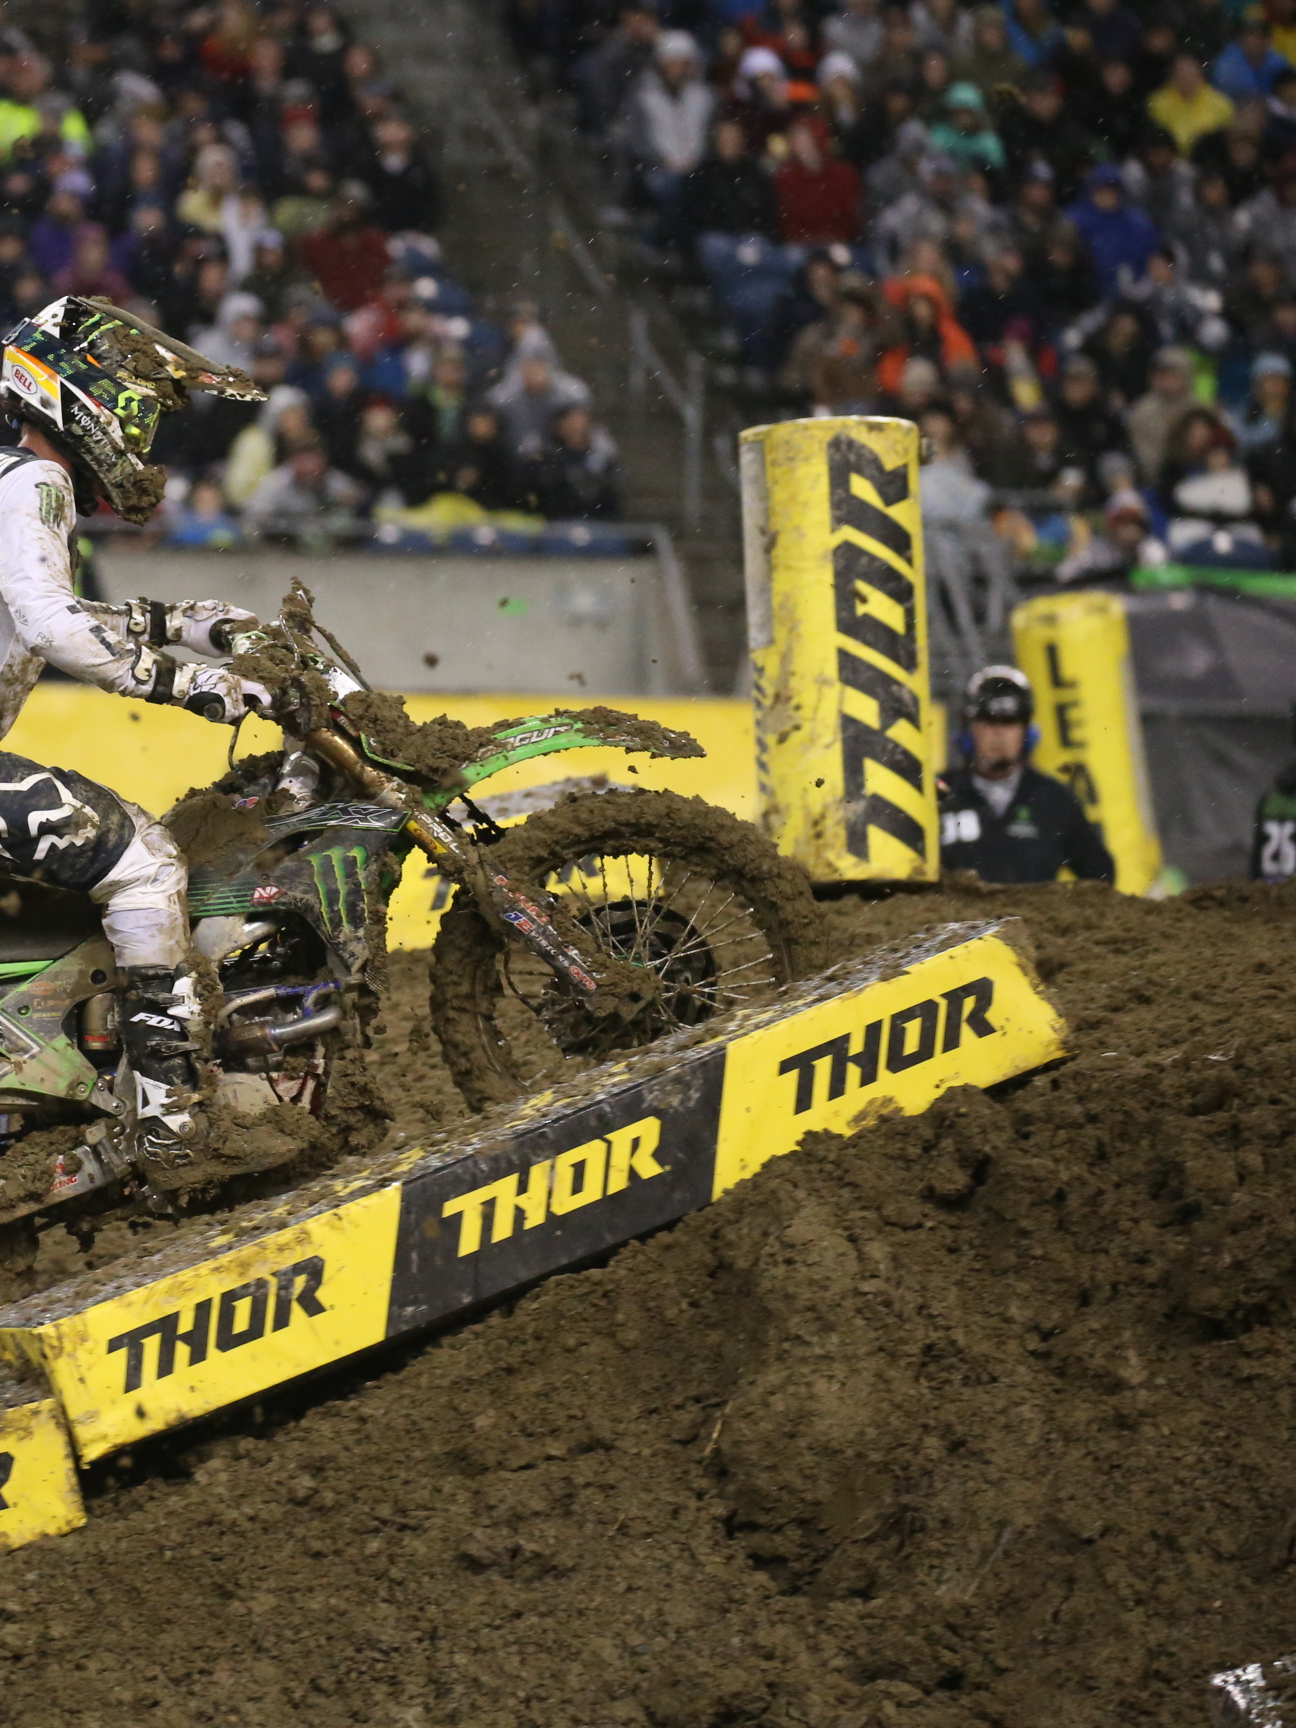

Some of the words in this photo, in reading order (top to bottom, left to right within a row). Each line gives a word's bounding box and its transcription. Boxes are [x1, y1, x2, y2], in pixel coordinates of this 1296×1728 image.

[13, 369, 35, 393] BELL
[70, 406, 116, 461] MONST
[827, 432, 926, 864] THOR
[129, 1012, 181, 1032] FOX
[778, 976, 998, 1116] THOR
[442, 1115, 666, 1258] THOR
[106, 1255, 329, 1395] THOR
